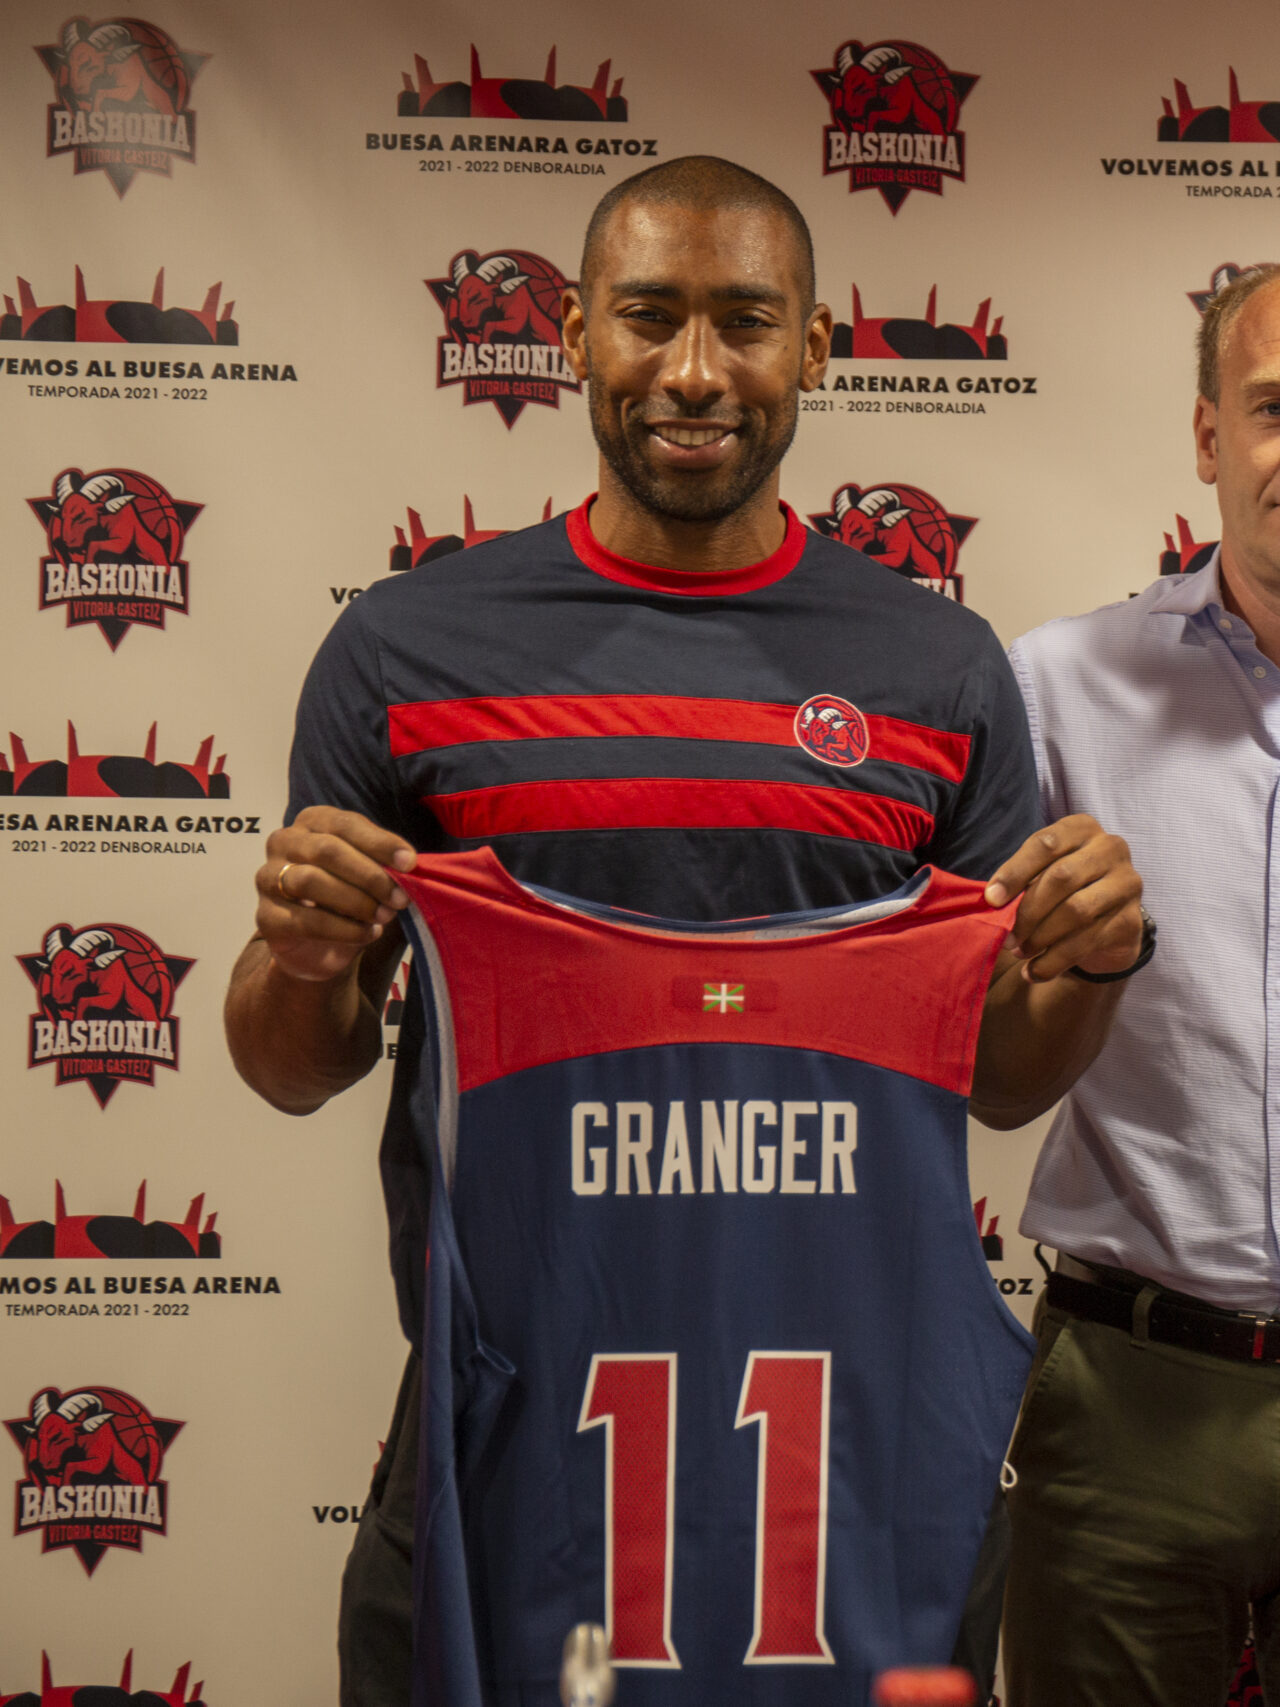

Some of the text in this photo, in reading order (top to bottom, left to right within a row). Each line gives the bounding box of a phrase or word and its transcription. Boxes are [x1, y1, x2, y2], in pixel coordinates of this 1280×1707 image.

[53, 111, 190, 152] BASKONIA
[366, 133, 657, 156] BUESA ARENARA GATOZ
[829, 130, 961, 170] BASKONIA
[419, 160, 451, 171] 2021
[465, 161, 499, 172] 2022
[504, 162, 605, 175] DENBORALDIA
[1101, 159, 1232, 176] VOLVEMOS
[1240, 160, 1268, 176] AL
[1185, 186, 1273, 198] TEMPORADA
[86, 361, 116, 377] AL
[124, 361, 203, 379] BUESA
[211, 363, 297, 381] ARENA
[28, 385, 120, 398] TEMPORADA
[125, 387, 157, 399] 2021
[172, 388, 207, 400] 2022
[833, 376, 949, 393] ARENARA
[957, 377, 1036, 393] GATOZ
[802, 400, 834, 412] 2021
[847, 401, 880, 412] 2022
[886, 402, 985, 413] DENBORALDIA
[45, 563, 184, 604] BASKONIA
[45, 815, 168, 832] ARENARA
[176, 816, 260, 833] GATOZ
[12, 840, 45, 852] 2021
[61, 841, 95, 852] 2022
[101, 841, 206, 853] DENBORALDIA
[34, 1020, 175, 1060] BASKONIA
[571, 1100, 857, 1196] GRANGER
[65, 1277, 95, 1294] AL
[104, 1277, 185, 1294] BUESA
[193, 1277, 280, 1293] ARENA
[6, 1304, 99, 1316] TEMPORADA
[104, 1304, 138, 1316] 2021
[153, 1304, 189, 1315] 2022
[20, 1486, 162, 1526] BASKONIA
[576, 1350, 836, 1670] 11
